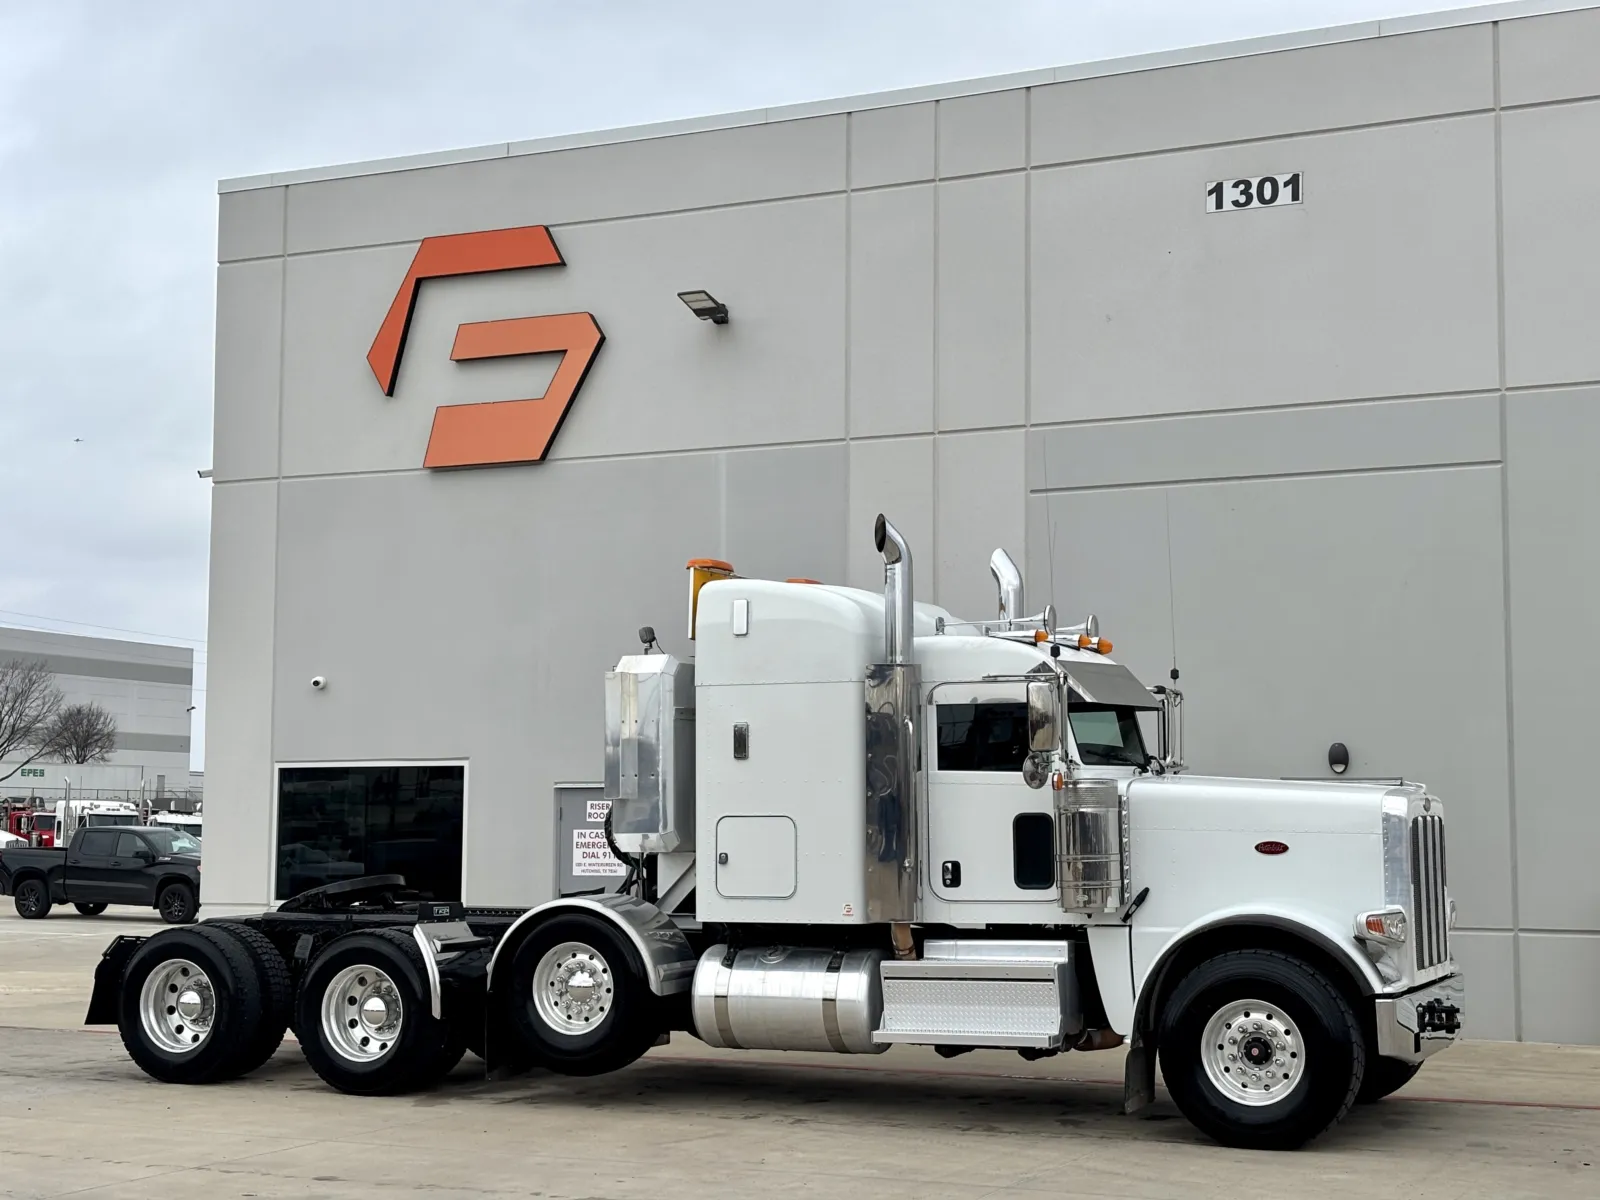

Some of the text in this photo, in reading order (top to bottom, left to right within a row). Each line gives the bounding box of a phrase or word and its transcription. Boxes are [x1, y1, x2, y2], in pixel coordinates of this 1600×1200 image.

[1207, 173, 1300, 211] 1301
[20, 768, 45, 777] EPES
[590, 803, 610, 811] RISER
[577, 831, 605, 839] IN CAS
[575, 841, 610, 849] EMERGE
[582, 851, 600, 859] DIAL
